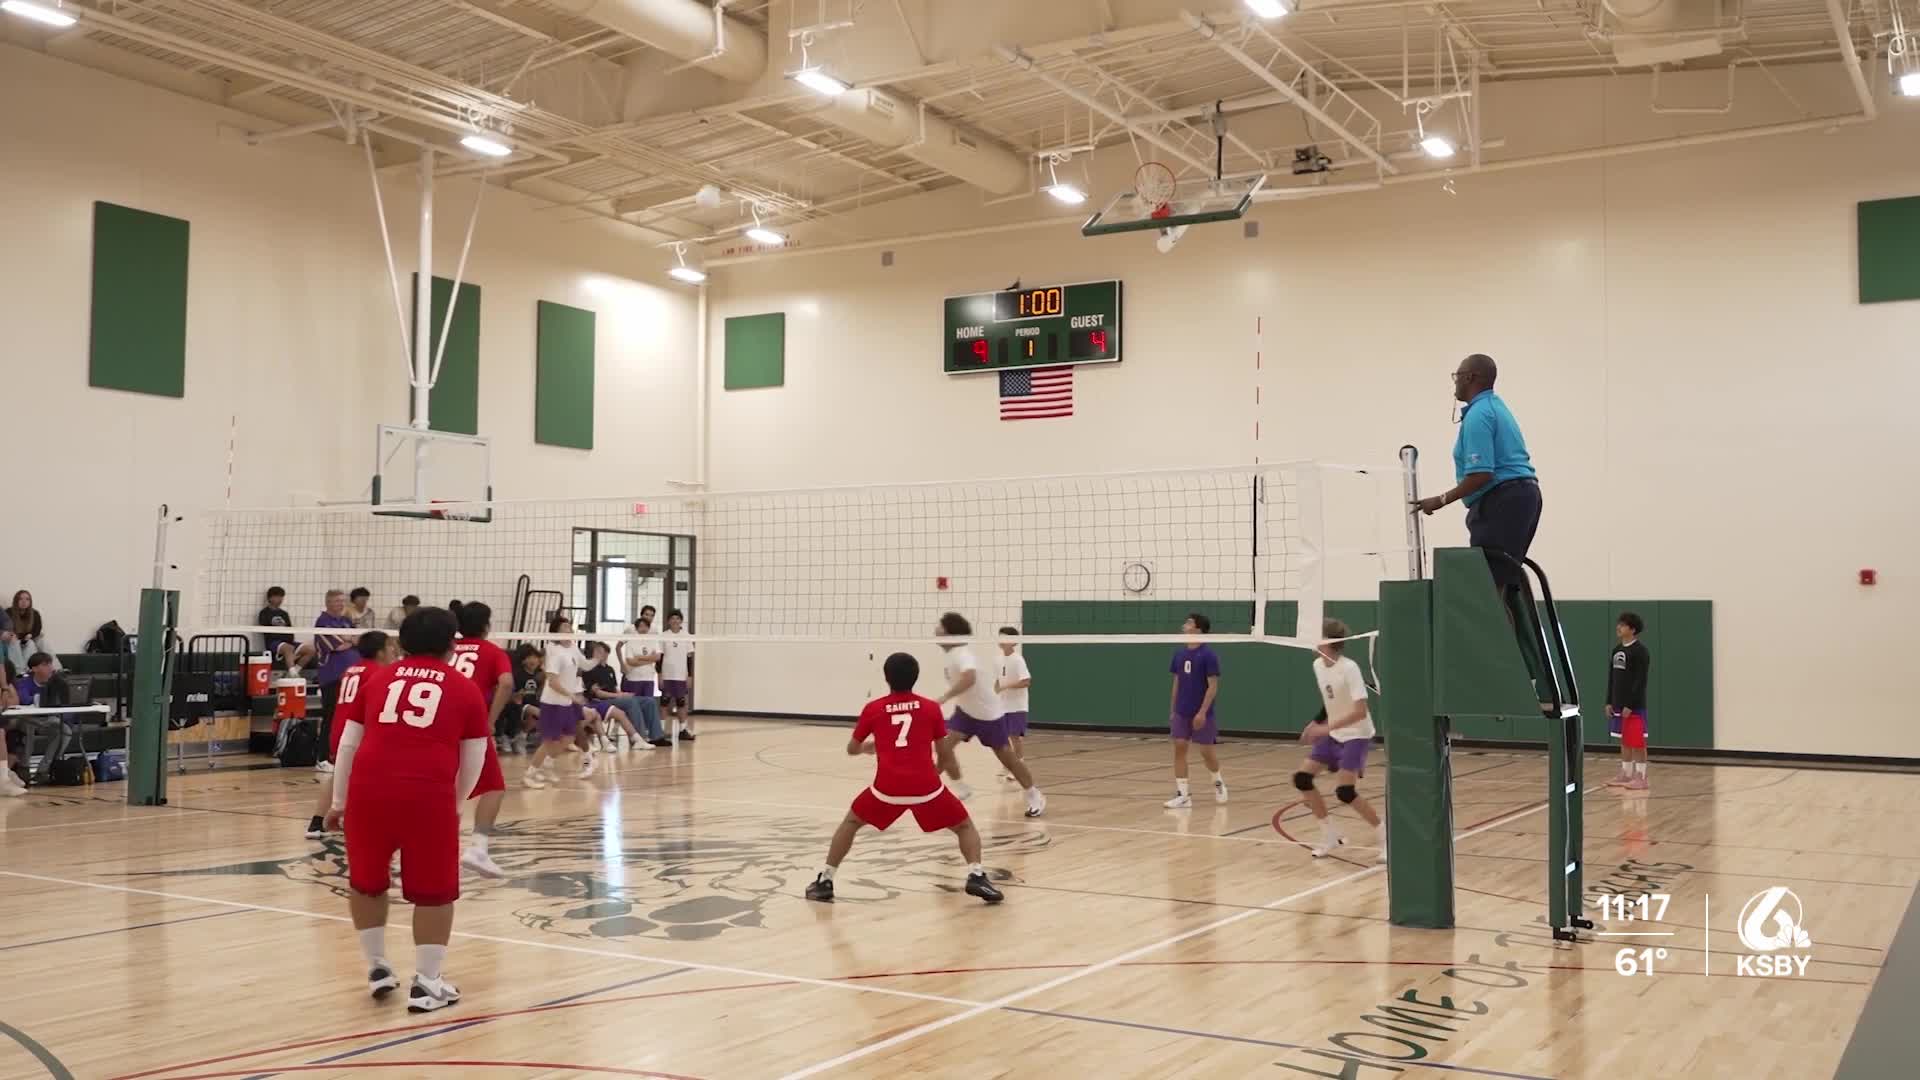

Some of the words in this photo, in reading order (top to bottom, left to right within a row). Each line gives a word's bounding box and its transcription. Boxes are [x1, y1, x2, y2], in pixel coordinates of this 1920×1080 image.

[1018, 289, 1060, 315] 1:00
[1070, 314, 1105, 329] GUEST
[956, 326, 985, 339] HOME
[1015, 327, 1040, 337] PERIOD
[1090, 331, 1107, 353] 4
[972, 340, 989, 364] 9
[1028, 339, 1033, 357] 1
[256, 668, 269, 683] G
[395, 666, 446, 682] SAINTS
[337, 674, 361, 704] 10
[378, 680, 443, 729] 19
[885, 700, 920, 713] SAINTS
[891, 713, 913, 748] 7
[1272, 988, 1489, 1080] HOME
[1441, 953, 1548, 989] OF
